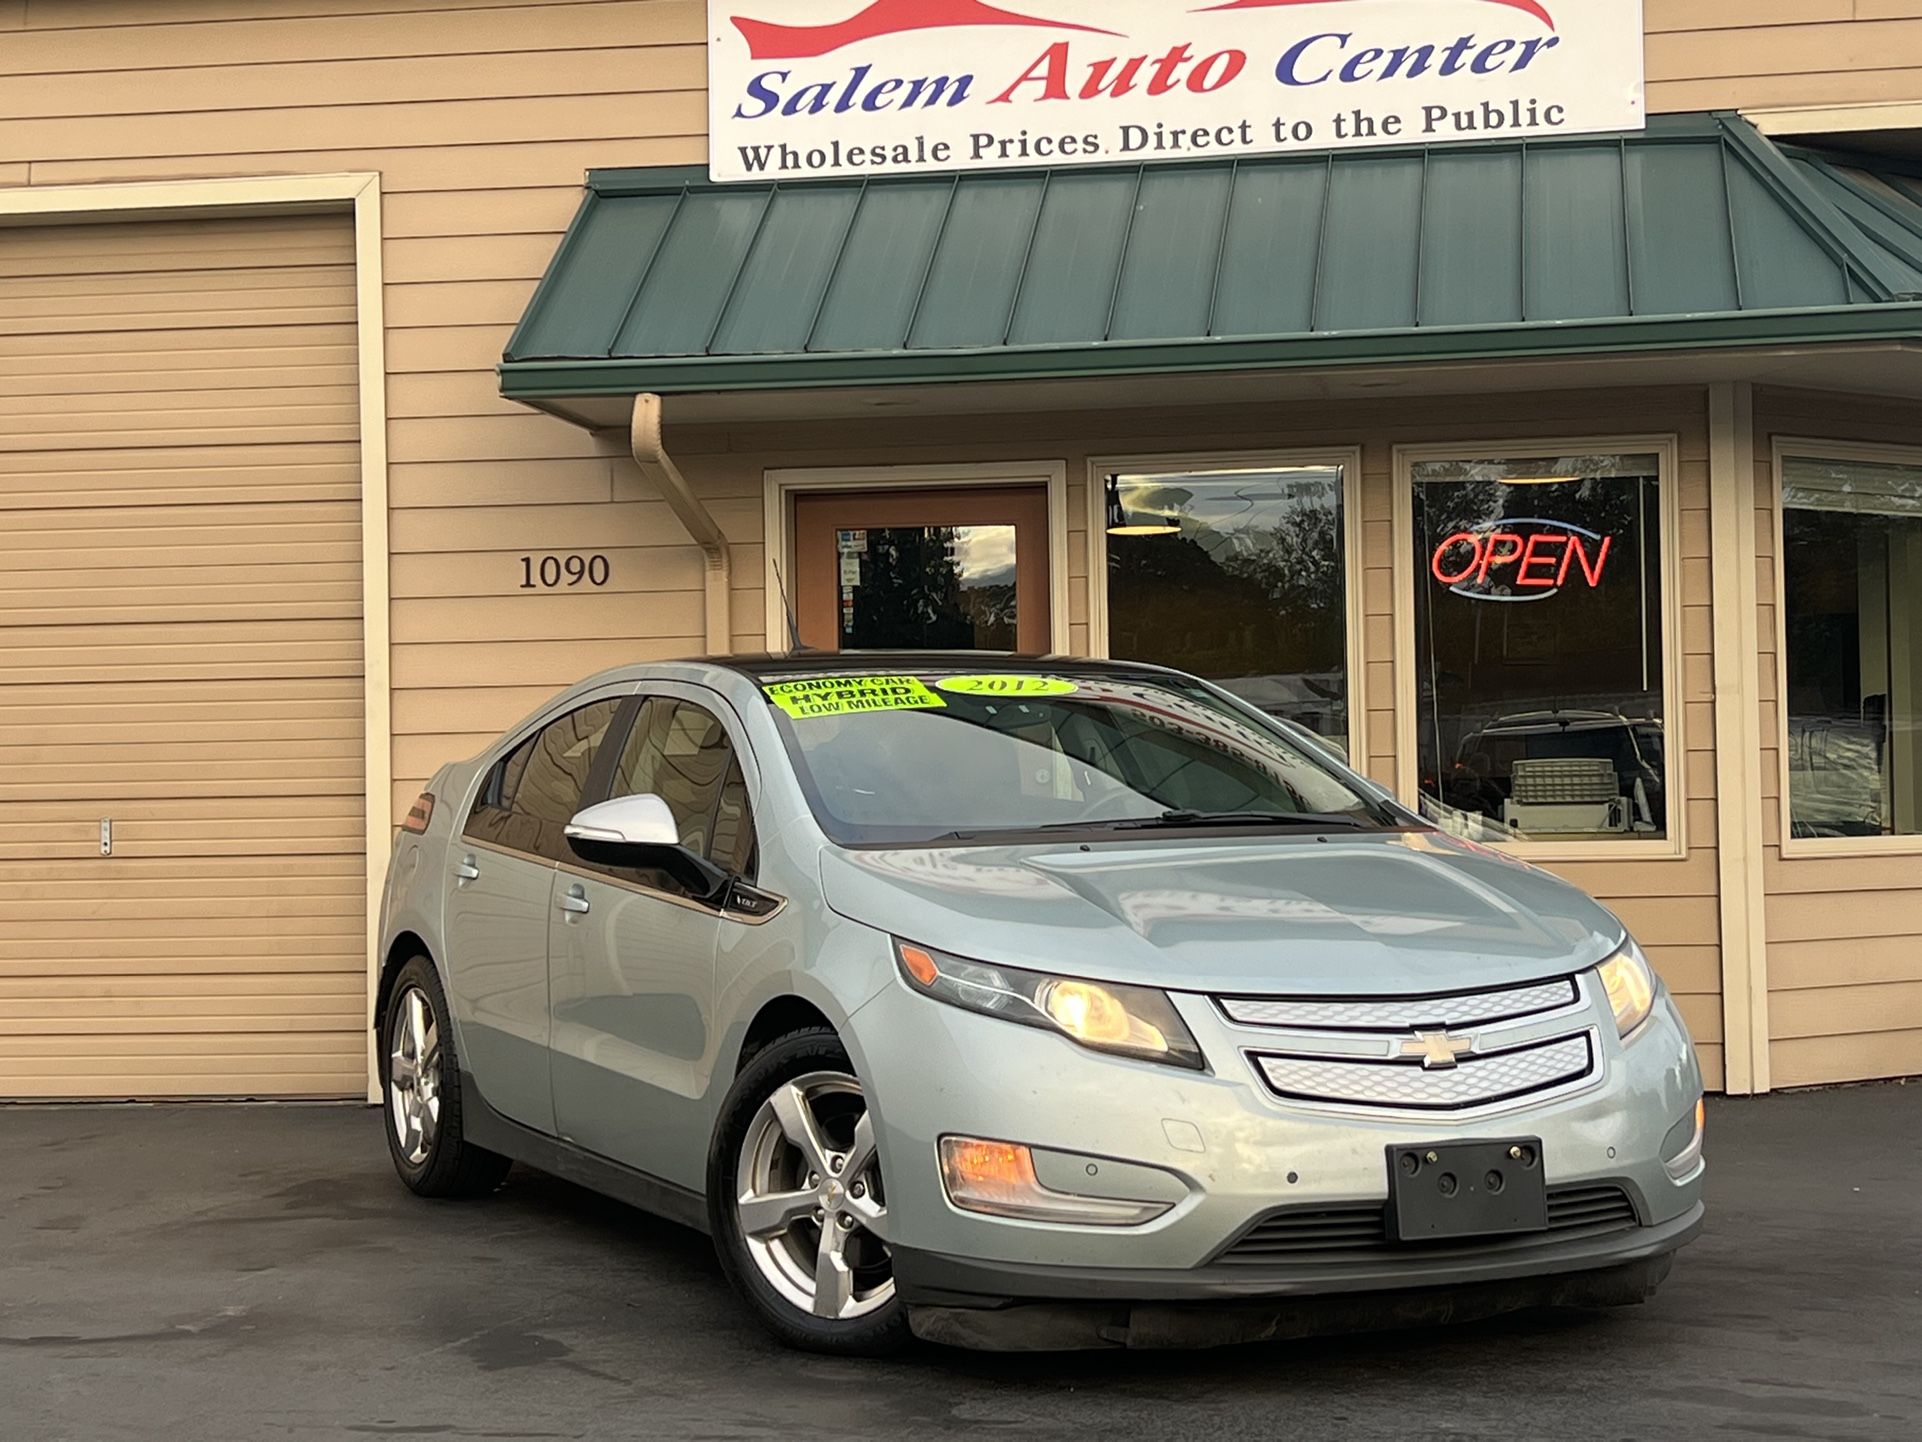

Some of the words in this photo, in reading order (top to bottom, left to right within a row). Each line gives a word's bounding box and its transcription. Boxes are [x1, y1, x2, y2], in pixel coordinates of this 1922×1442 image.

[732, 63, 974, 119] Salem
[986, 41, 1246, 104] Auto
[1275, 32, 1560, 86] Center
[737, 135, 951, 172] Wholesale
[1119, 118, 1254, 152] Direct
[1273, 116, 1313, 142] to
[1333, 110, 1402, 139] the
[1421, 98, 1565, 133] Public
[520, 555, 610, 588] 1090
[1432, 532, 1611, 587] OPEN
[768, 678, 865, 695] ECONOMY
[869, 676, 913, 687] CAR
[790, 685, 912, 705] HYBRID
[966, 679, 1050, 692] 2012
[799, 702, 840, 715] LOW
[849, 694, 930, 710] MILEAGE
